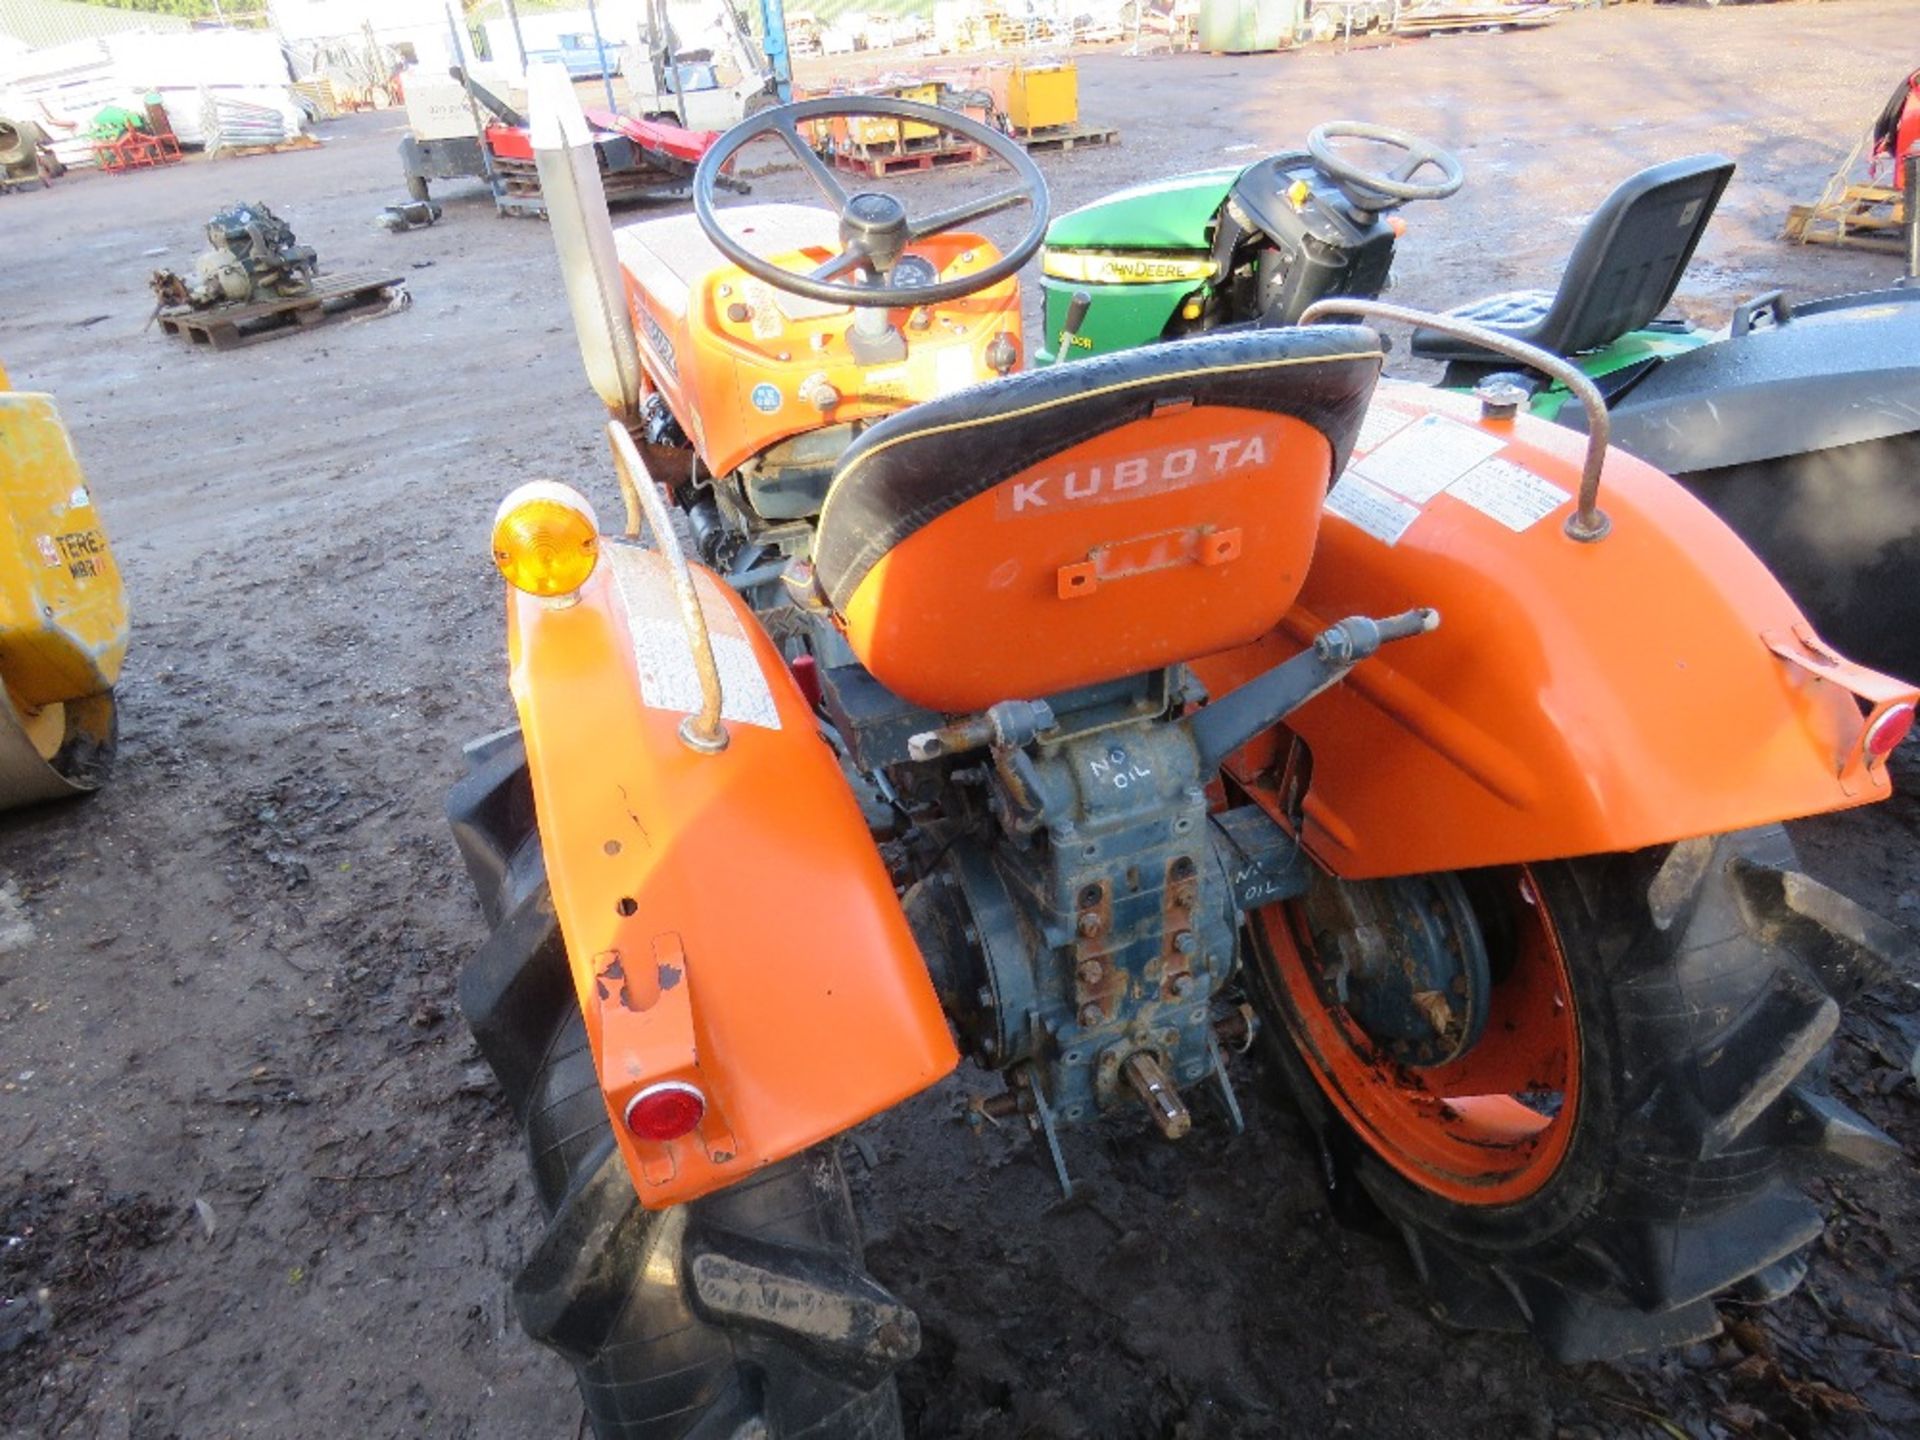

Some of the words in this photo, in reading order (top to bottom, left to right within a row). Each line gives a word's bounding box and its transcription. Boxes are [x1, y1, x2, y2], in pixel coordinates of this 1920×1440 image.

[1134, 260, 1187, 278] DEERE
[1012, 435, 1266, 512] KUBOTA
[1089, 749, 1126, 778] NO
[1112, 766, 1152, 789] OIL
[1244, 881, 1281, 901] OIL
